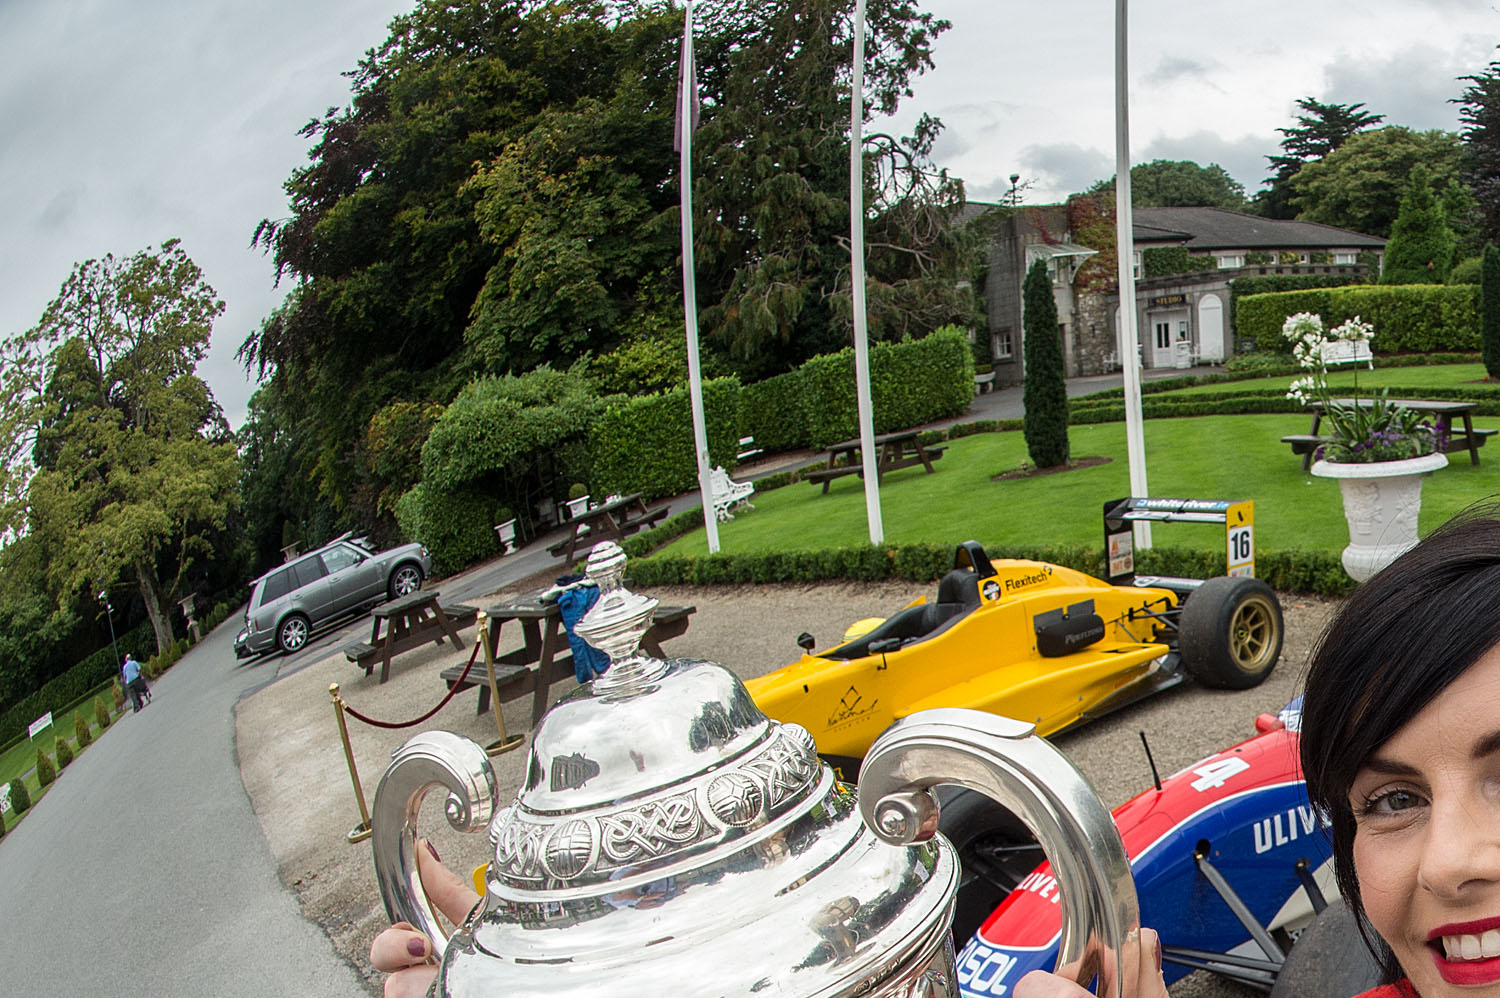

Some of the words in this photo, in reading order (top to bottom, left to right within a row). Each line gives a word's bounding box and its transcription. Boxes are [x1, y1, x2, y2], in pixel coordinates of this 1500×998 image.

[1146, 499, 1230, 510] whiteriver.ie
[1231, 530, 1250, 560] 16
[1005, 572, 1048, 591] Flexitech
[1189, 756, 1251, 793] 4
[957, 937, 1018, 996] ASOL
